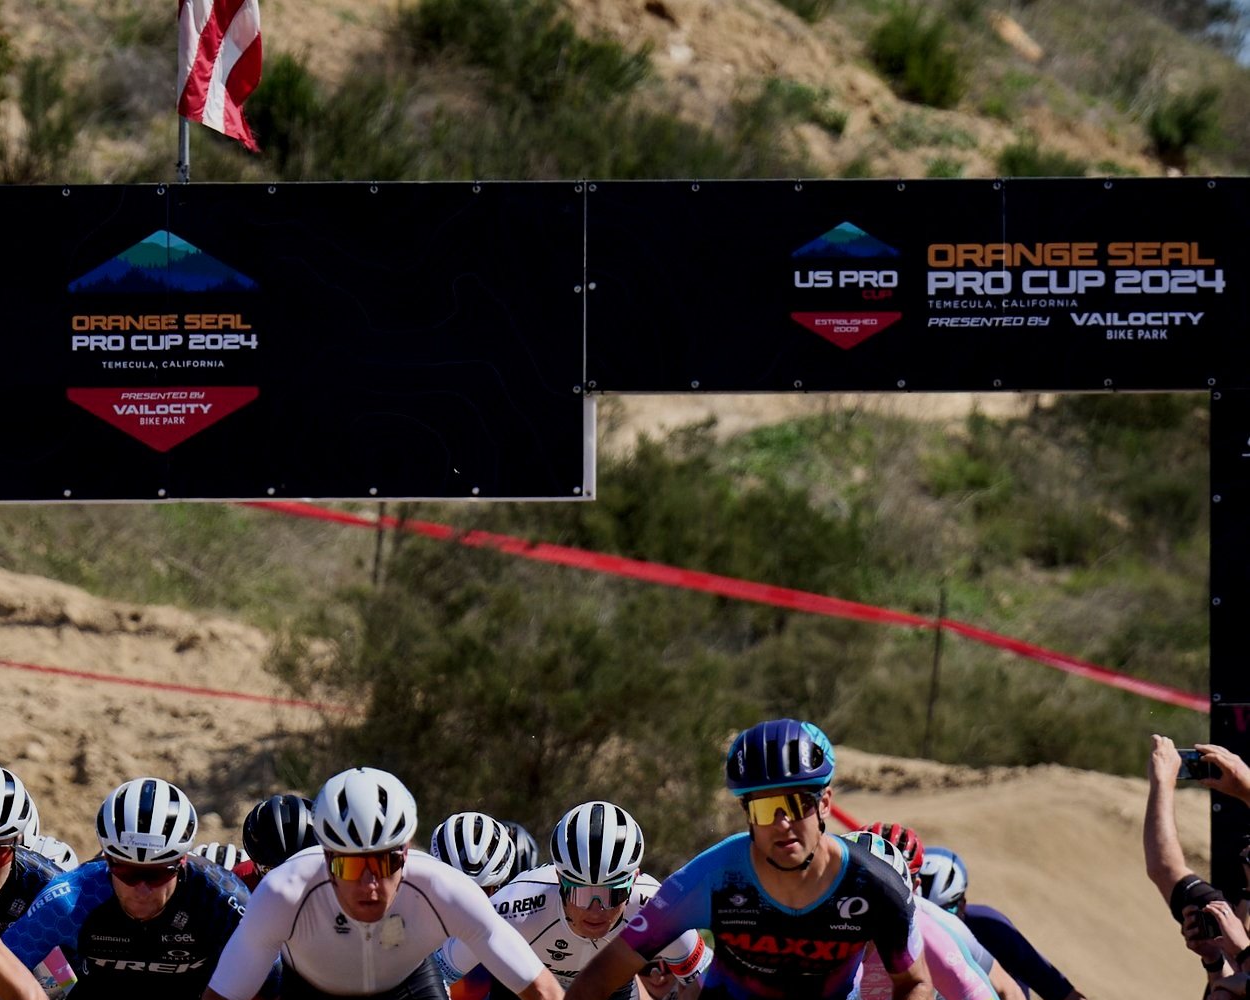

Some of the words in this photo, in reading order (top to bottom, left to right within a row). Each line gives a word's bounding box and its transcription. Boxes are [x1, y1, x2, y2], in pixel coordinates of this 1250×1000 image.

[927, 242, 1098, 267] ORANGE
[1107, 242, 1215, 266] SEAL
[794, 270, 833, 288] US
[839, 270, 898, 288] PRO
[927, 270, 1012, 295] PRO
[1022, 270, 1106, 294] CUP
[1114, 269, 1226, 294] 2024
[862, 289, 892, 299] CUP
[928, 299, 997, 309] TEMECULA,
[1002, 298, 1079, 308] CALIFORNIA
[72, 314, 178, 331] ORANGE
[184, 314, 252, 330] SEAL
[815, 318, 878, 326] ESTABLISHED
[927, 316, 1024, 328] PRESENTED
[1027, 316, 1050, 327] BY
[1070, 311, 1205, 327] VAILOCITY
[1106, 329, 1134, 340] BIKE
[1138, 329, 1168, 340] PARK
[72, 335, 125, 351] PRO
[130, 335, 183, 351] CUP
[188, 334, 258, 350] 2024
[102, 361, 159, 369] TEMECULA,
[162, 360, 225, 369] CALIFORNIA
[121, 392, 187, 400] PRESENTED
[189, 391, 205, 400] BY
[113, 403, 212, 416] VAILOCITY
[139, 417, 160, 426] BIKE
[162, 416, 185, 426] PARK
[512, 894, 547, 914] RENO
[829, 922, 861, 931] wahoo
[718, 931, 865, 961] MAXXI
[87, 957, 207, 974] TREK
